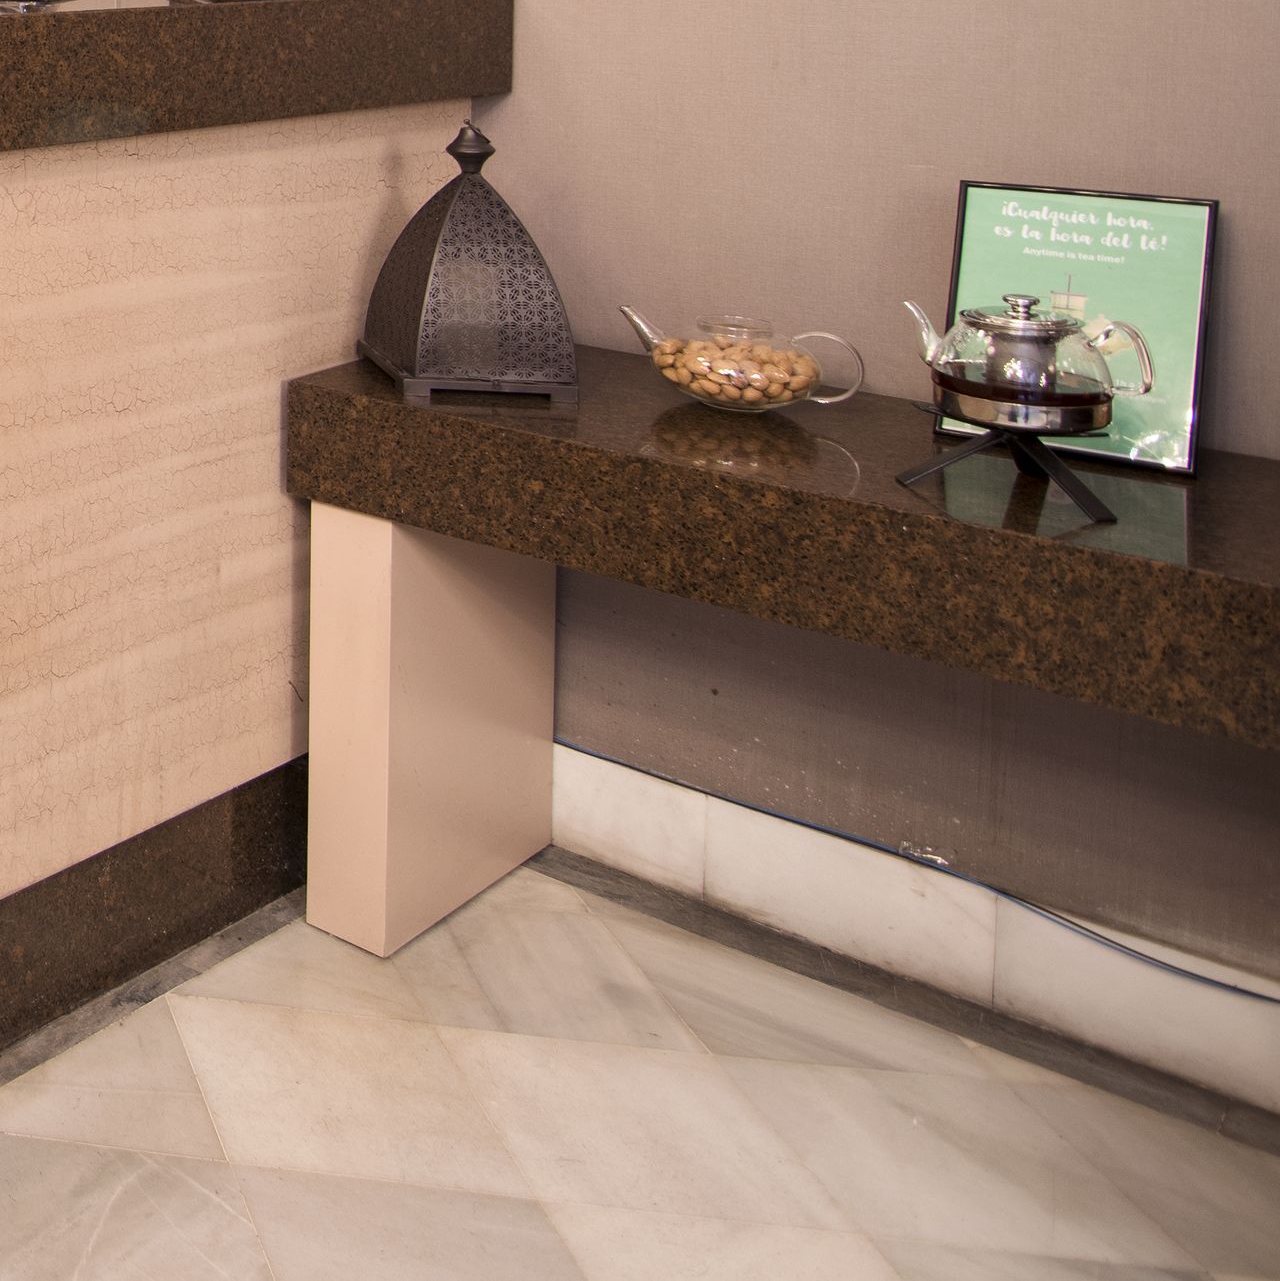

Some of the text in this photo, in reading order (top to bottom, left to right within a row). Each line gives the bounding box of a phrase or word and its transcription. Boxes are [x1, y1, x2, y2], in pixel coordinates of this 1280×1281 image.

[994, 225, 1014, 238] es
[1021, 224, 1043, 240] la
[1050, 227, 1093, 245] hora
[1100, 231, 1132, 248] del
[1023, 246, 1125, 264] Anytime is tea time!
